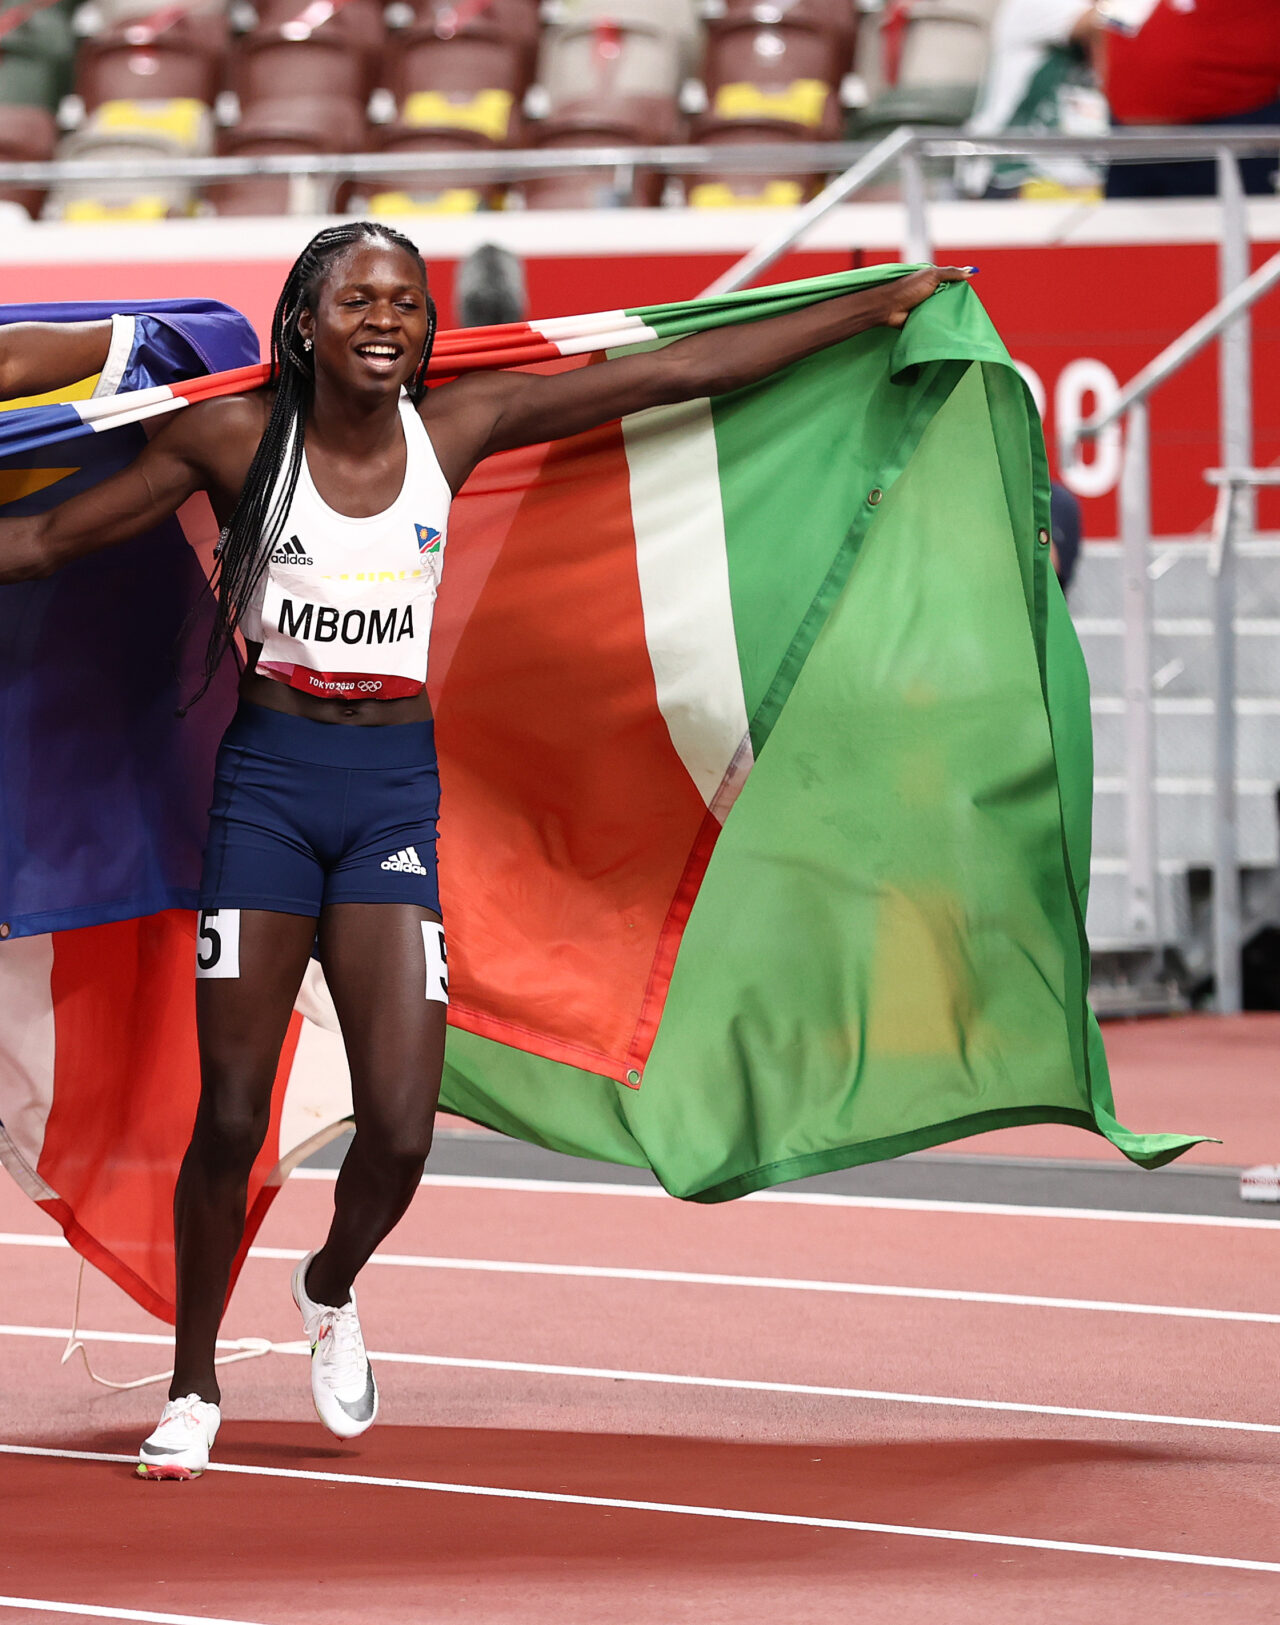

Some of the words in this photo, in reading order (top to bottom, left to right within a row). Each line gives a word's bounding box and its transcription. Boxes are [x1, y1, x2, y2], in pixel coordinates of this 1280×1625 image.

[270, 553, 314, 566] adidas
[277, 598, 415, 645] MBOMA
[309, 675, 335, 691] TOKYO
[335, 681, 355, 691] 2020
[380, 859, 427, 876] adidas
[197, 908, 222, 970] 5
